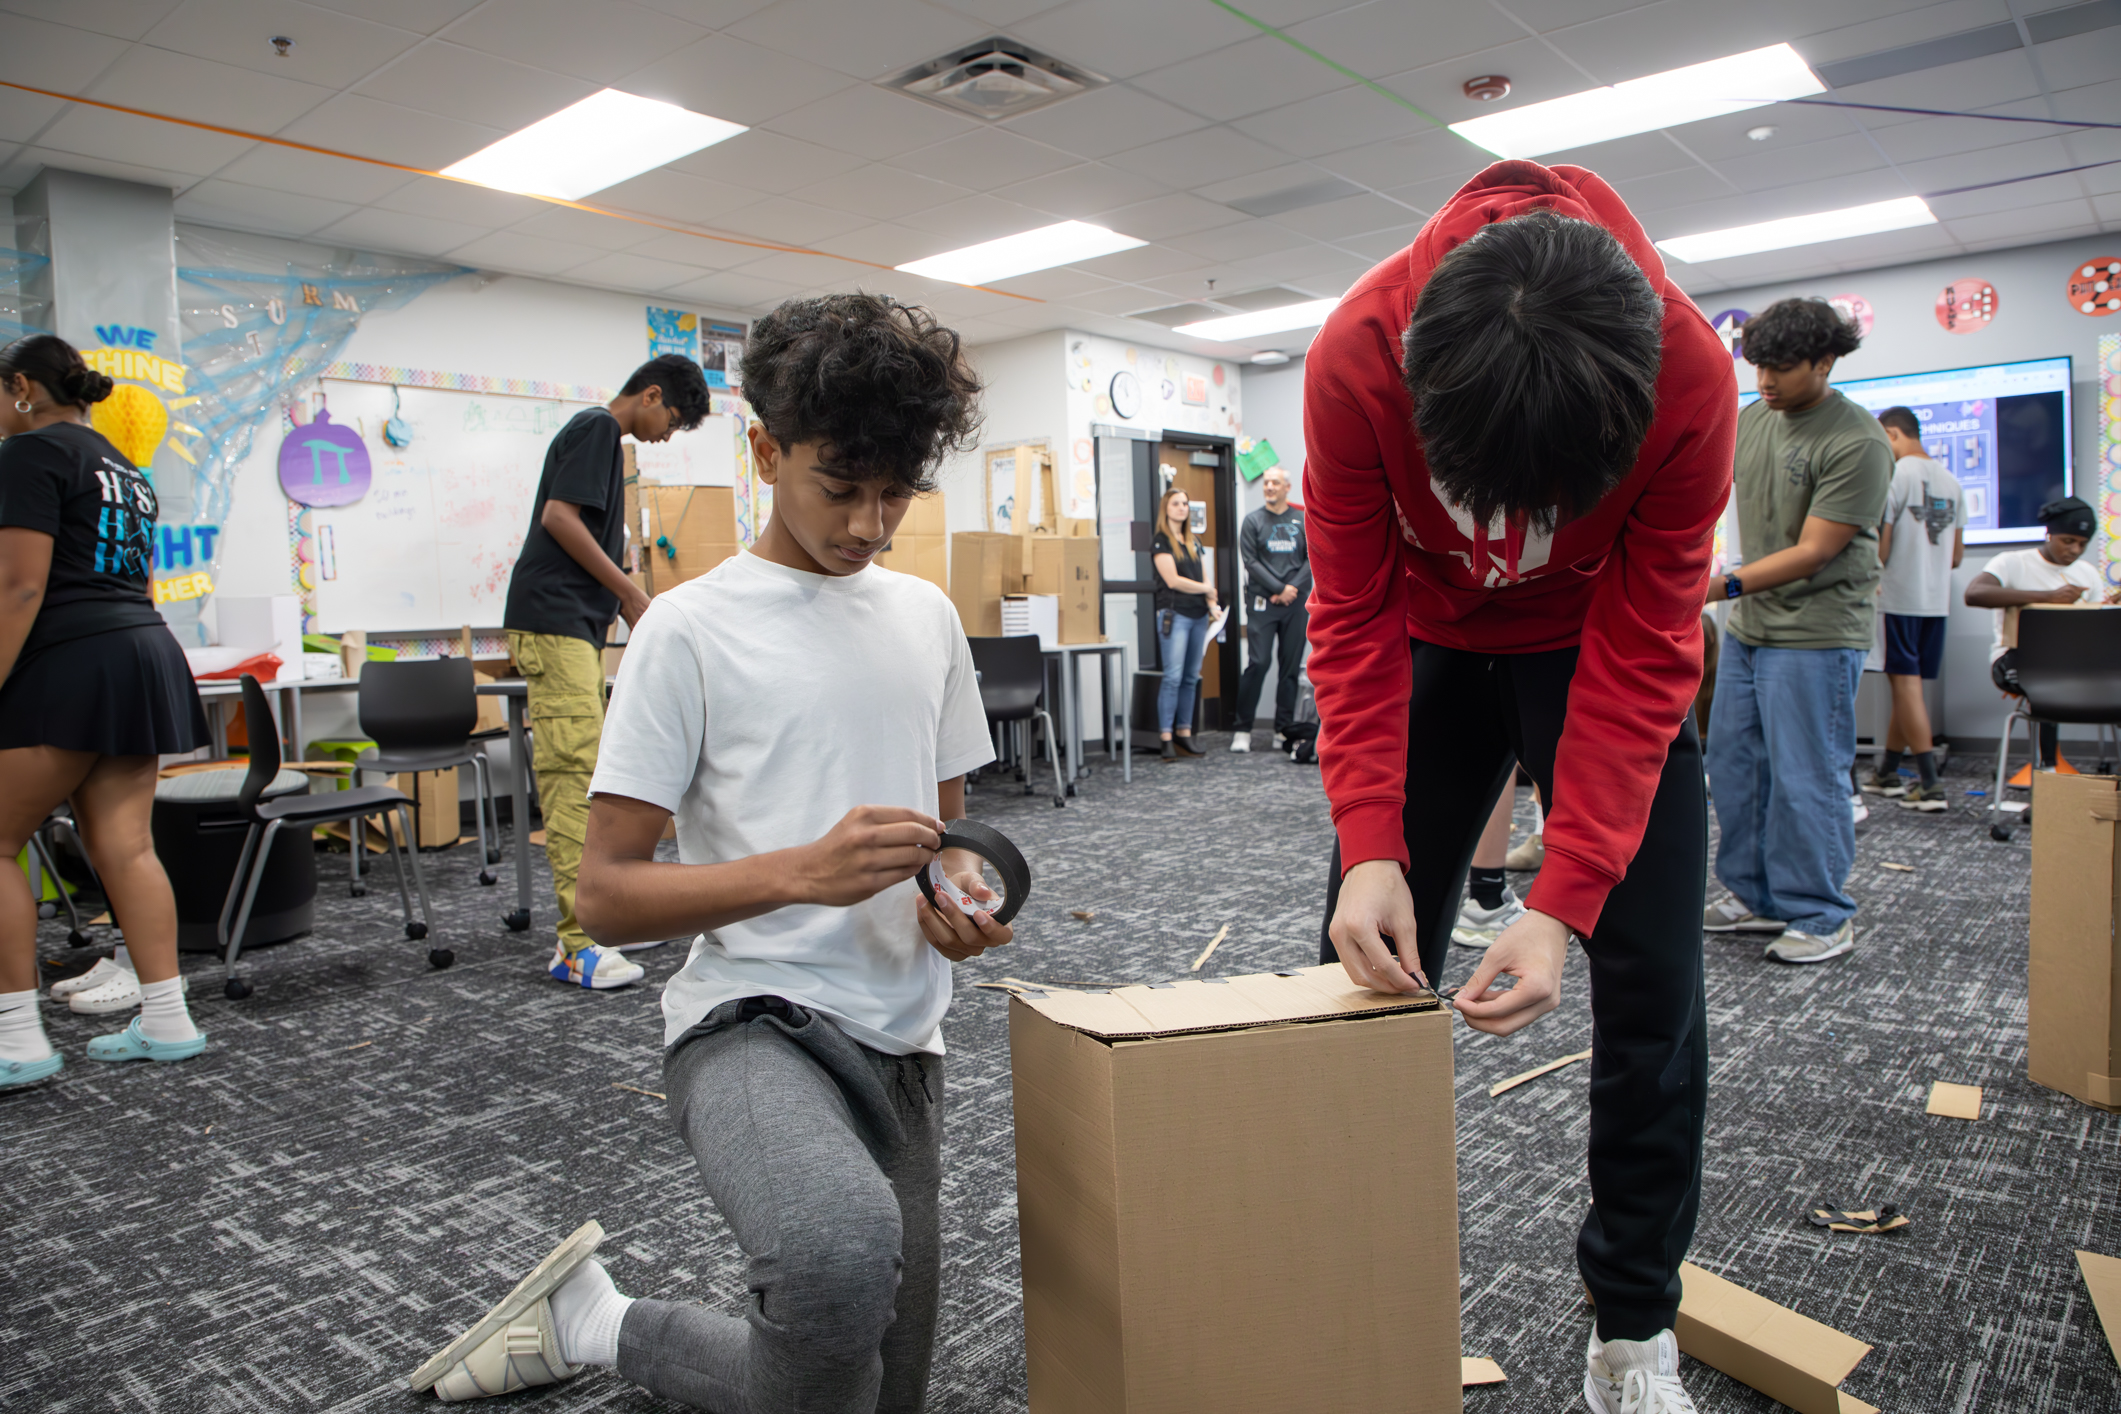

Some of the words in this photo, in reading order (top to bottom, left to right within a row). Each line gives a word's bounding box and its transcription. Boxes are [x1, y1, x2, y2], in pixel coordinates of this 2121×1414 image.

[94, 323, 158, 350] WE
[153, 523, 220, 573] HT
[153, 571, 215, 604] HER
